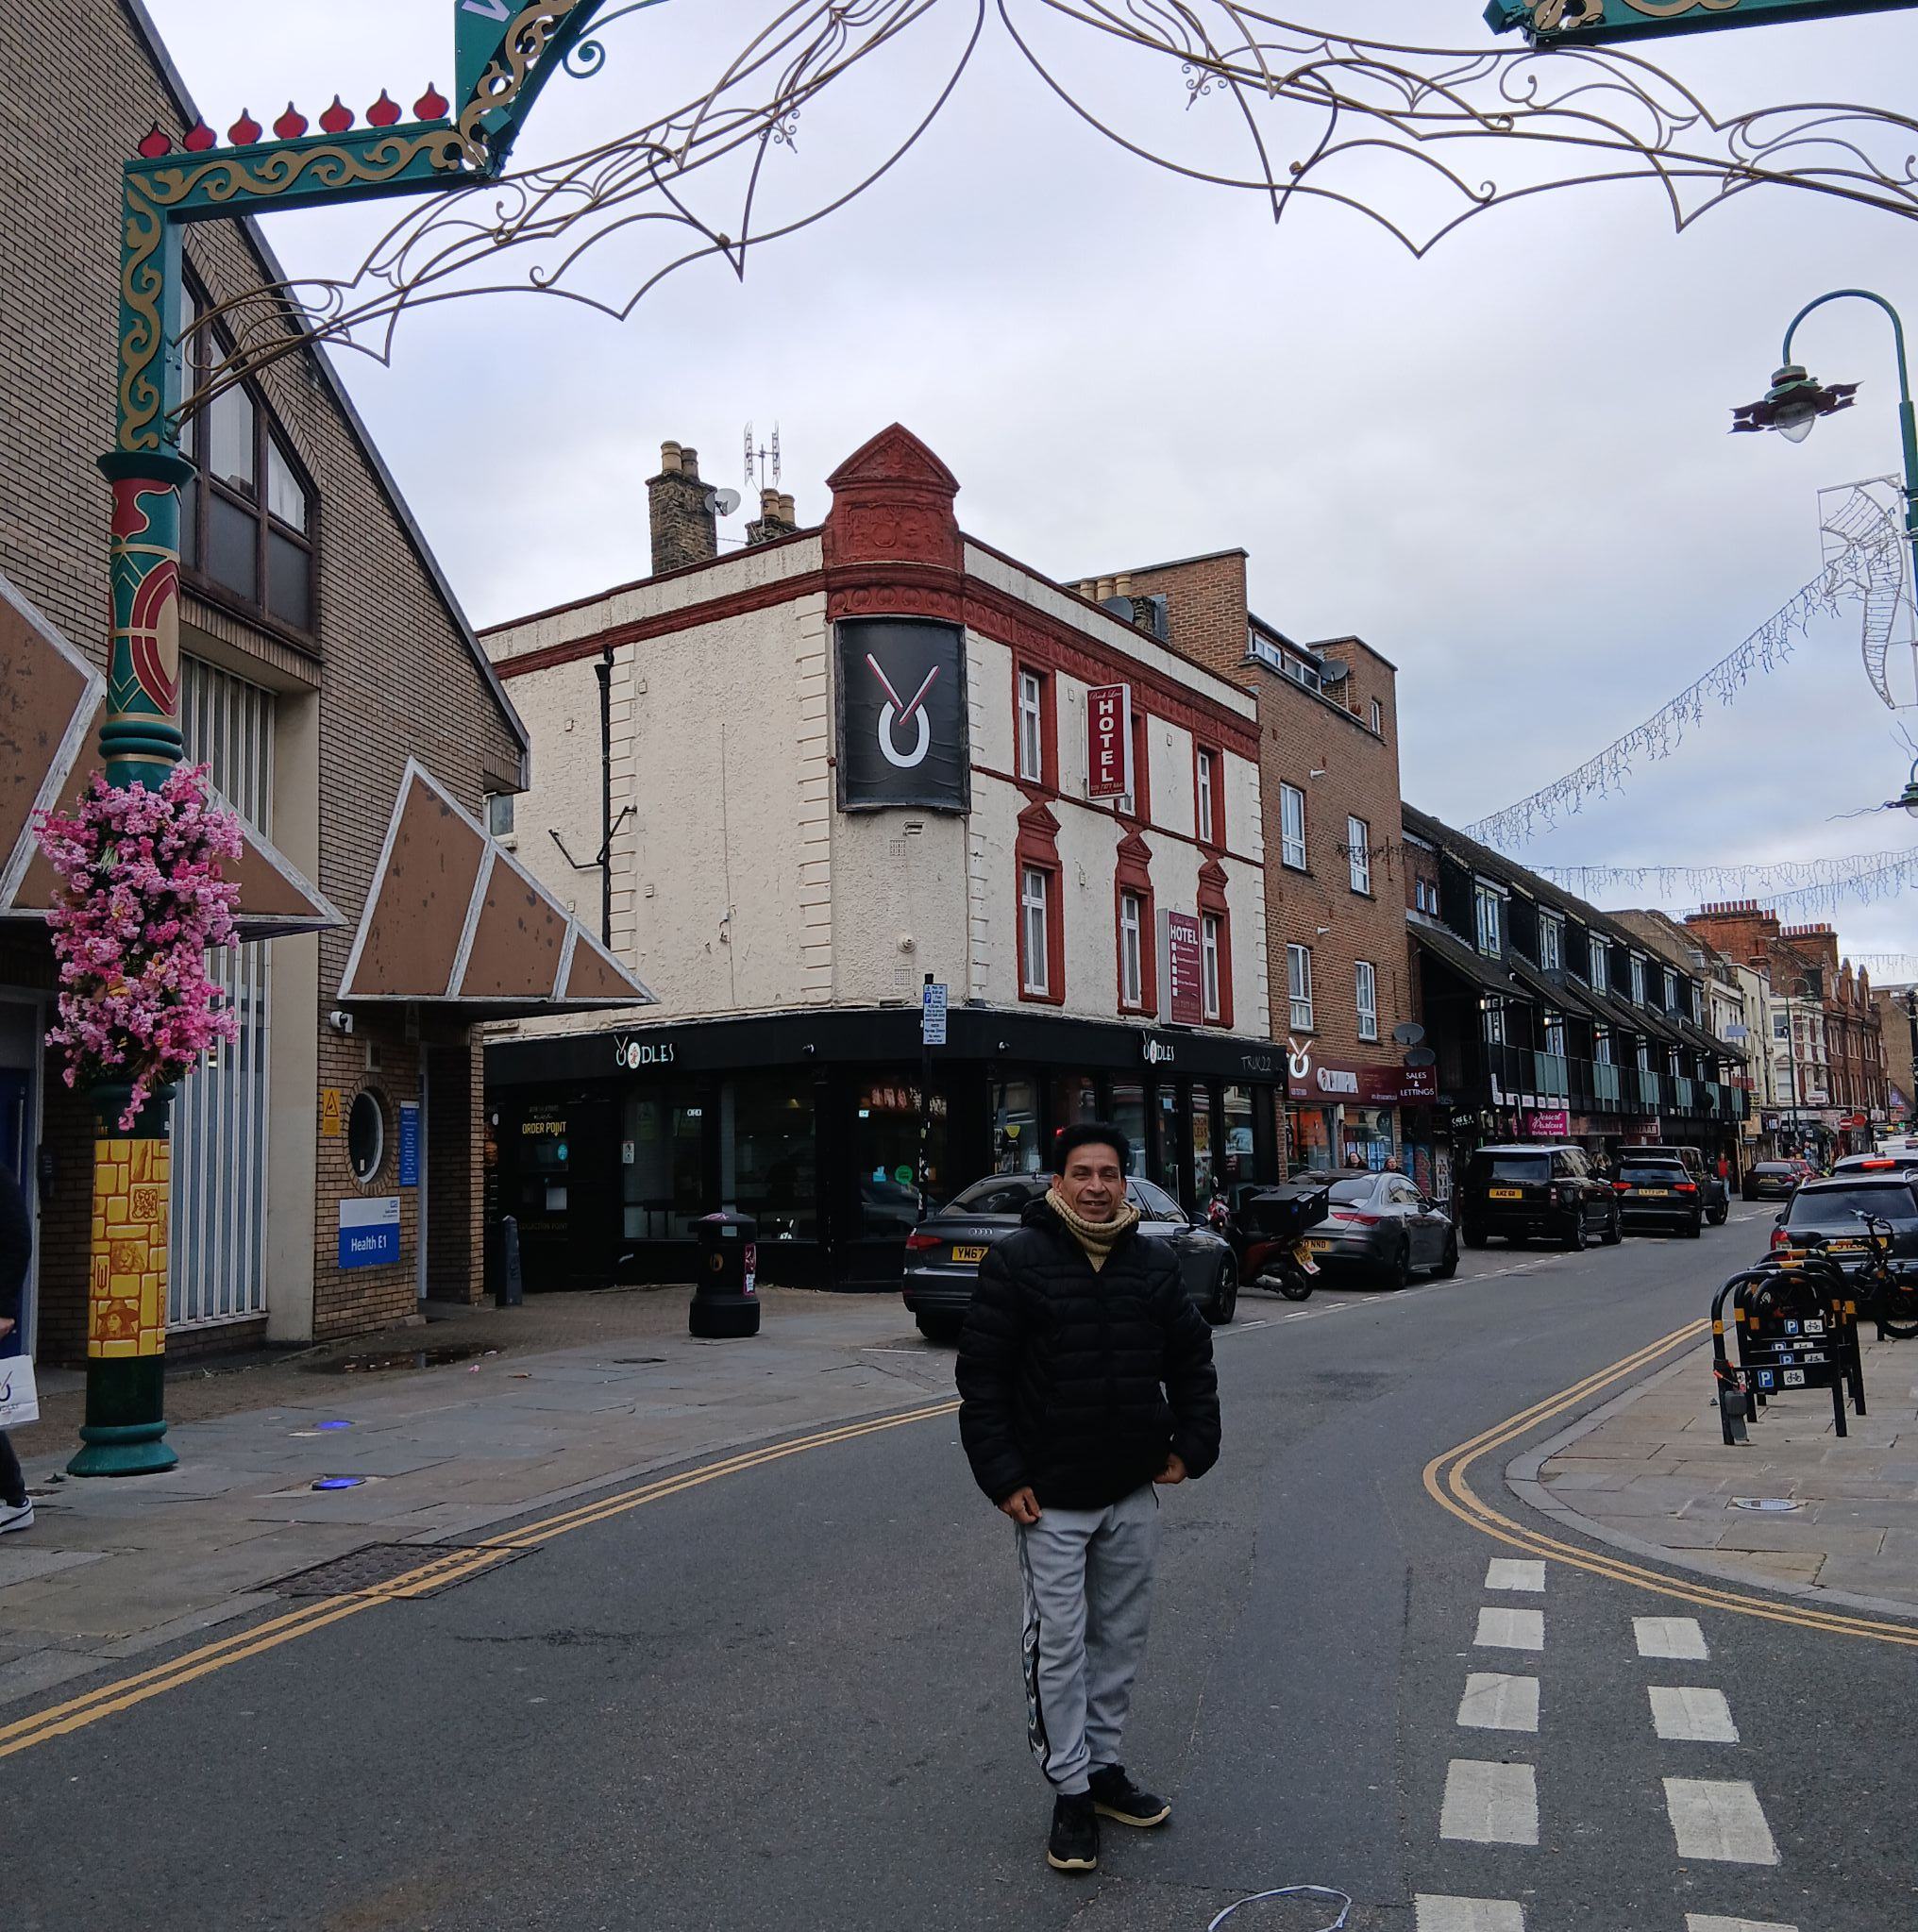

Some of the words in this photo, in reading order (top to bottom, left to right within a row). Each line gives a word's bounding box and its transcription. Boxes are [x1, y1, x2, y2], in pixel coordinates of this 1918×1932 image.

[1099, 699, 1114, 782] HOTEL
[1169, 924, 1198, 946] HOTEL
[1405, 1071, 1427, 1080] SALES
[1400, 1087, 1435, 1097] LETTINGS
[522, 1122, 545, 1134] ORDER
[546, 1121, 567, 1136] POINT
[351, 1235, 377, 1252] Health
[378, 1235, 387, 1249] E1
[1787, 1321, 1795, 1333] P
[1762, 1371, 1771, 1386] P
